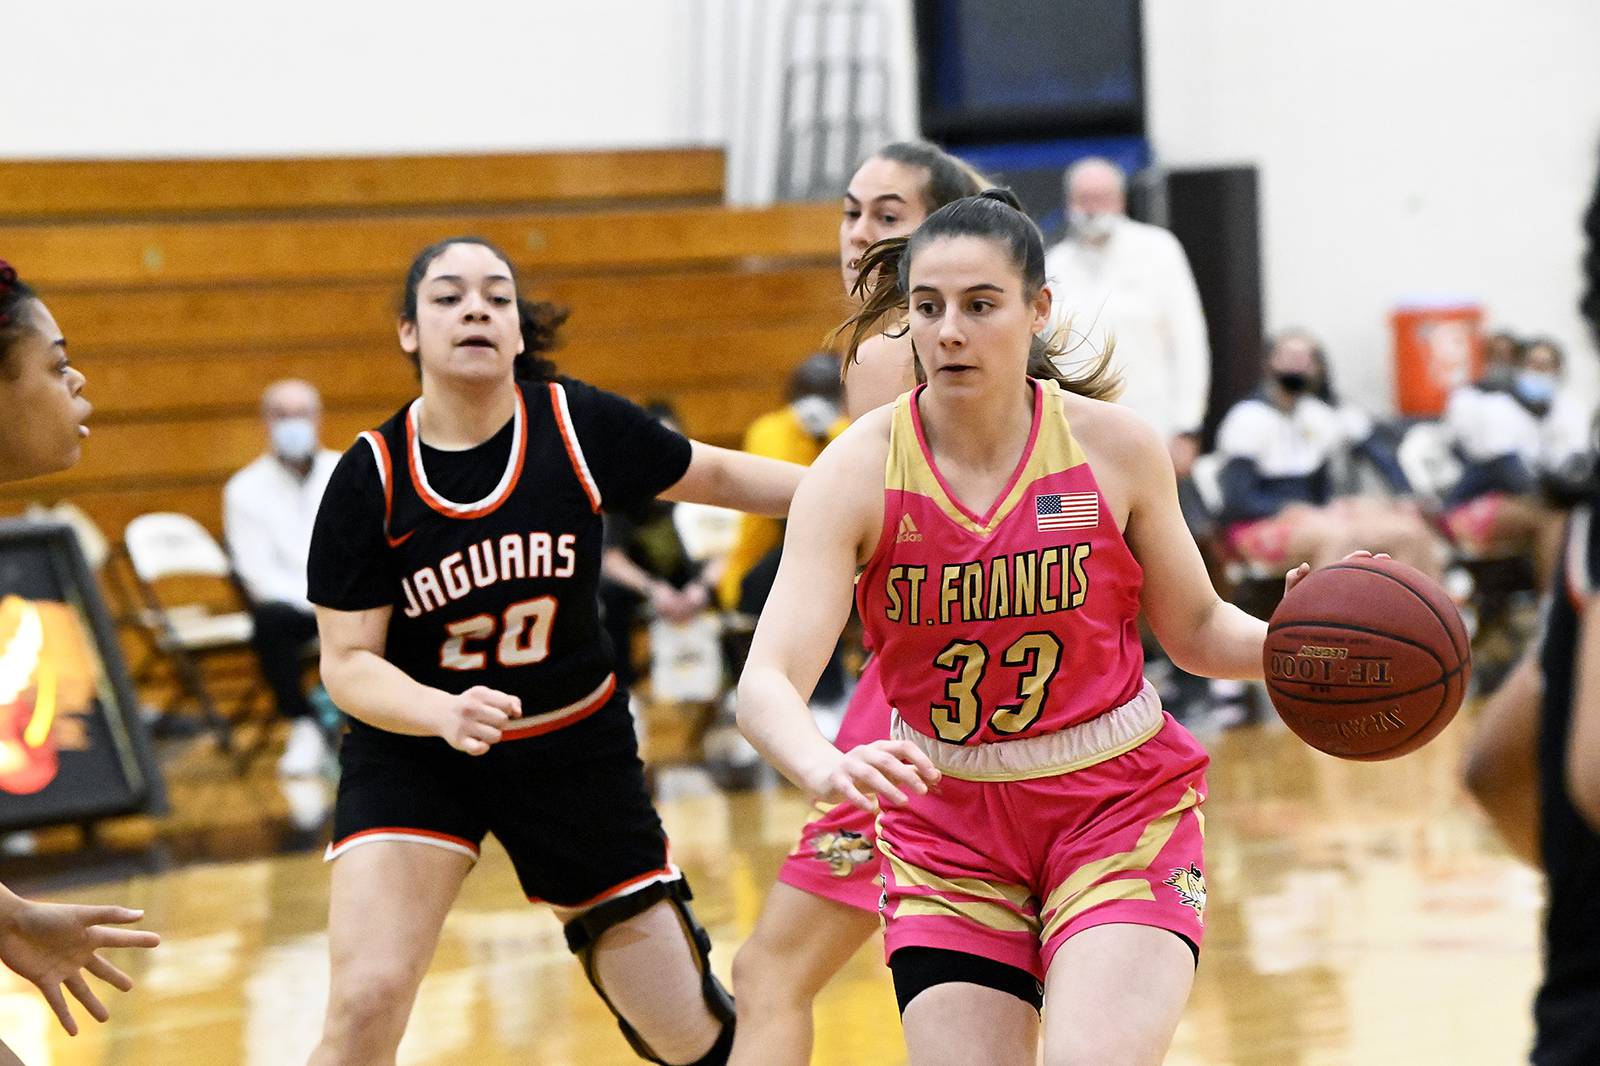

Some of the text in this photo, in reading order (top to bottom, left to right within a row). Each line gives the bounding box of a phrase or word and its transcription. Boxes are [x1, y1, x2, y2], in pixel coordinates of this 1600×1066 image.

[401, 532, 576, 618] JAGUARS
[440, 594, 558, 671] 20
[1270, 654, 1393, 686] TF-1000
[930, 630, 1064, 746] 33
